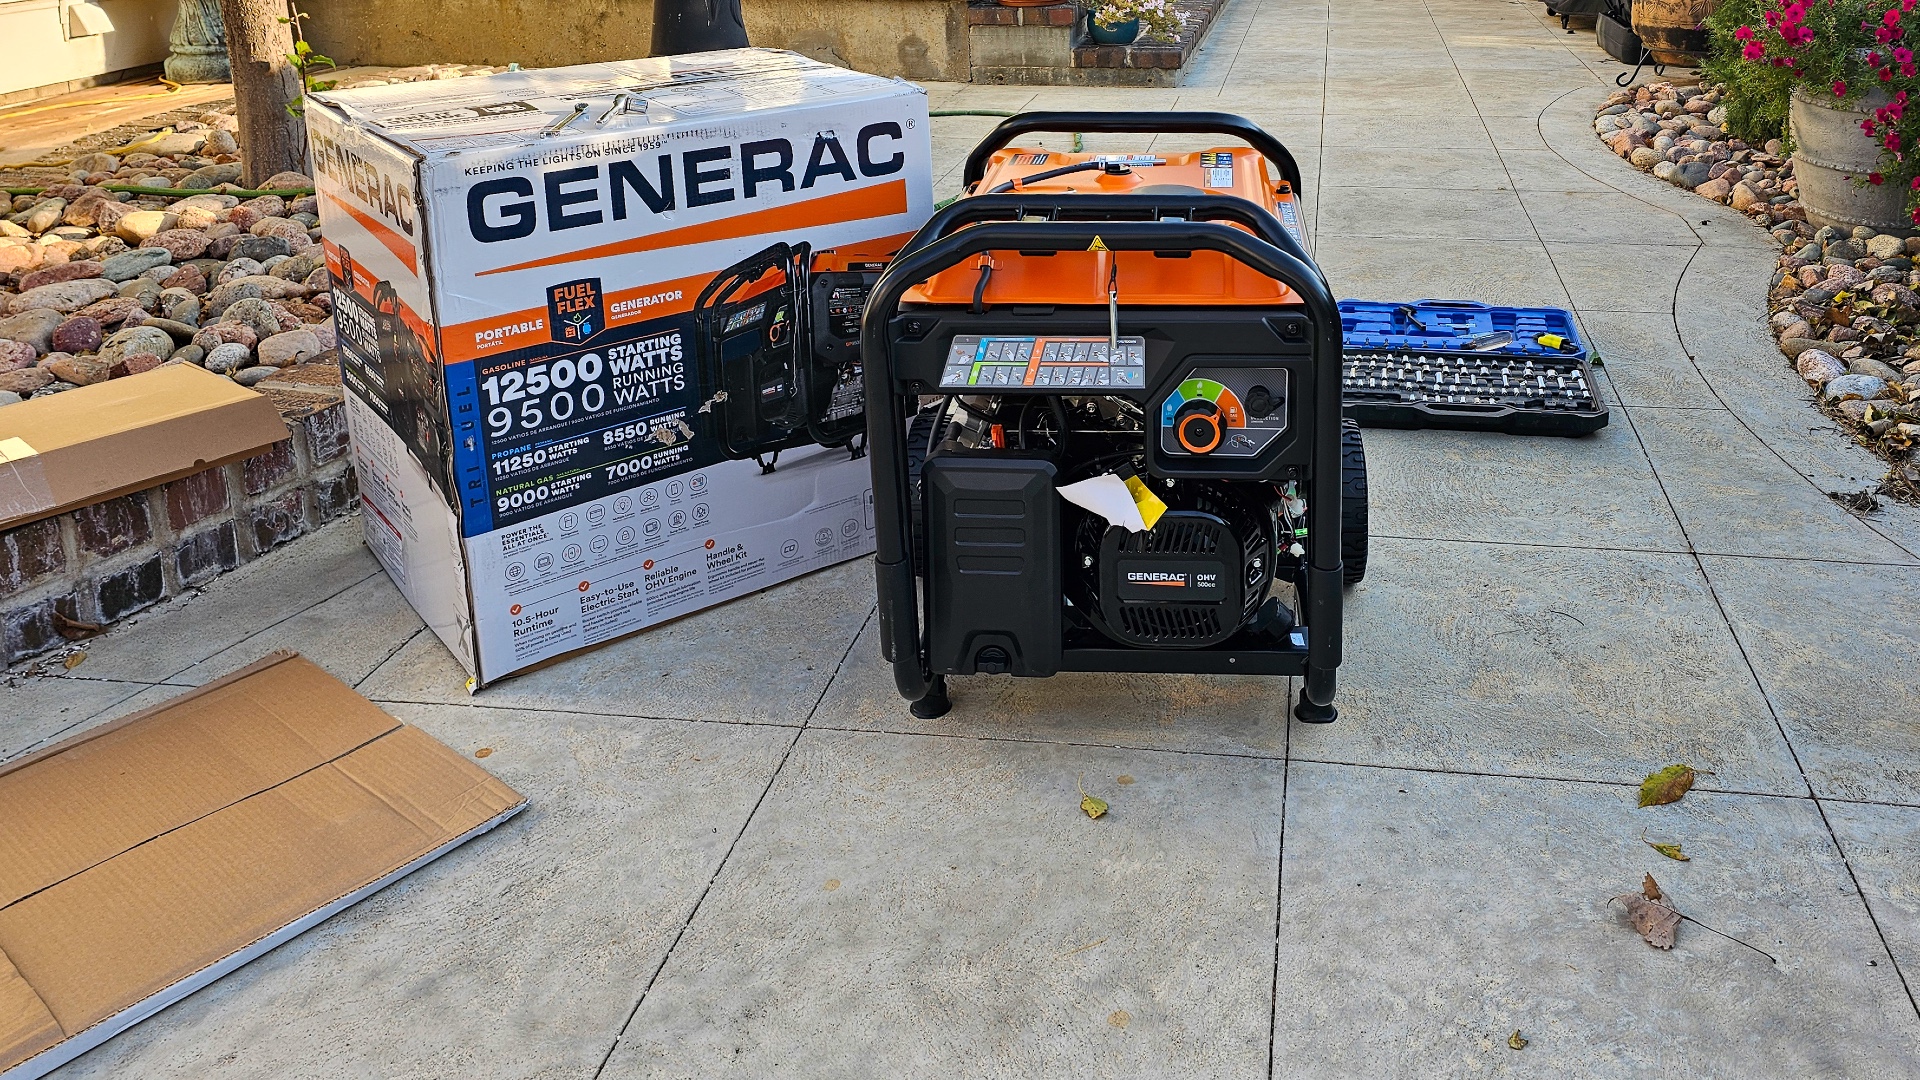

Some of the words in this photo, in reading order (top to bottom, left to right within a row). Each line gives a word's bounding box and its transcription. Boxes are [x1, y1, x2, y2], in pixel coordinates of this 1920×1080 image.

[464, 162, 515, 177] KEEPING
[518, 158, 539, 169] THE
[542, 153, 582, 165] LIGHTS
[587, 150, 602, 159] ON
[604, 144, 636, 156] SINCE
[311, 128, 414, 237] GENERAC
[553, 282, 596, 301] FUEL
[610, 291, 683, 313] GENERATOR
[333, 286, 359, 323] 12500
[556, 296, 596, 314] FLEX
[337, 308, 363, 346] 9500
[475, 319, 544, 343] PORTABLE
[608, 333, 682, 360] STARTING
[482, 359, 527, 375] GASOLINE
[608, 345, 683, 376] WATTS
[481, 353, 603, 406] 12500
[612, 362, 684, 389] RUNNING
[613, 374, 685, 406] WATTS
[487, 384, 605, 438] 9500
[650, 410, 686, 426] RUNNING
[508, 431, 530, 441] VATIOS
[585, 411, 605, 420] VATIOS
[603, 421, 647, 445] 8550
[491, 443, 532, 460] PROPANE
[547, 436, 590, 454] STARTING
[548, 447, 578, 461] WATTS
[653, 445, 689, 460] RUNNING
[492, 449, 547, 475] 11250
[605, 455, 652, 480] 7000
[653, 454, 681, 467] WATTS
[510, 468, 531, 477] VATIOS
[550, 472, 592, 490] STARTING
[466, 466, 484, 508] TRI
[495, 481, 535, 496] NATURAL
[536, 474, 554, 485] GAS
[551, 482, 581, 497] WATTS
[497, 485, 549, 512] 9000
[514, 504, 535, 514] VATIOS
[501, 528, 527, 540] POWER
[528, 523, 542, 531] THE
[502, 529, 545, 546] ESSENTIALS
[502, 543, 516, 552] ALL
[517, 539, 526, 547] AT
[706, 547, 736, 561] Handle
[736, 543, 744, 551] &
[706, 554, 734, 570] Wheel
[735, 551, 747, 561] Kit
[644, 565, 678, 582] Reliable
[645, 577, 666, 590] OHV
[668, 569, 697, 583] Engine
[1127, 572, 1185, 581] GENERAC
[580, 581, 635, 604] Easy-to-Use
[581, 596, 616, 613] Electric
[617, 588, 639, 601] Start
[512, 607, 559, 628] 10.5-Hour
[513, 619, 554, 637] Runtime
